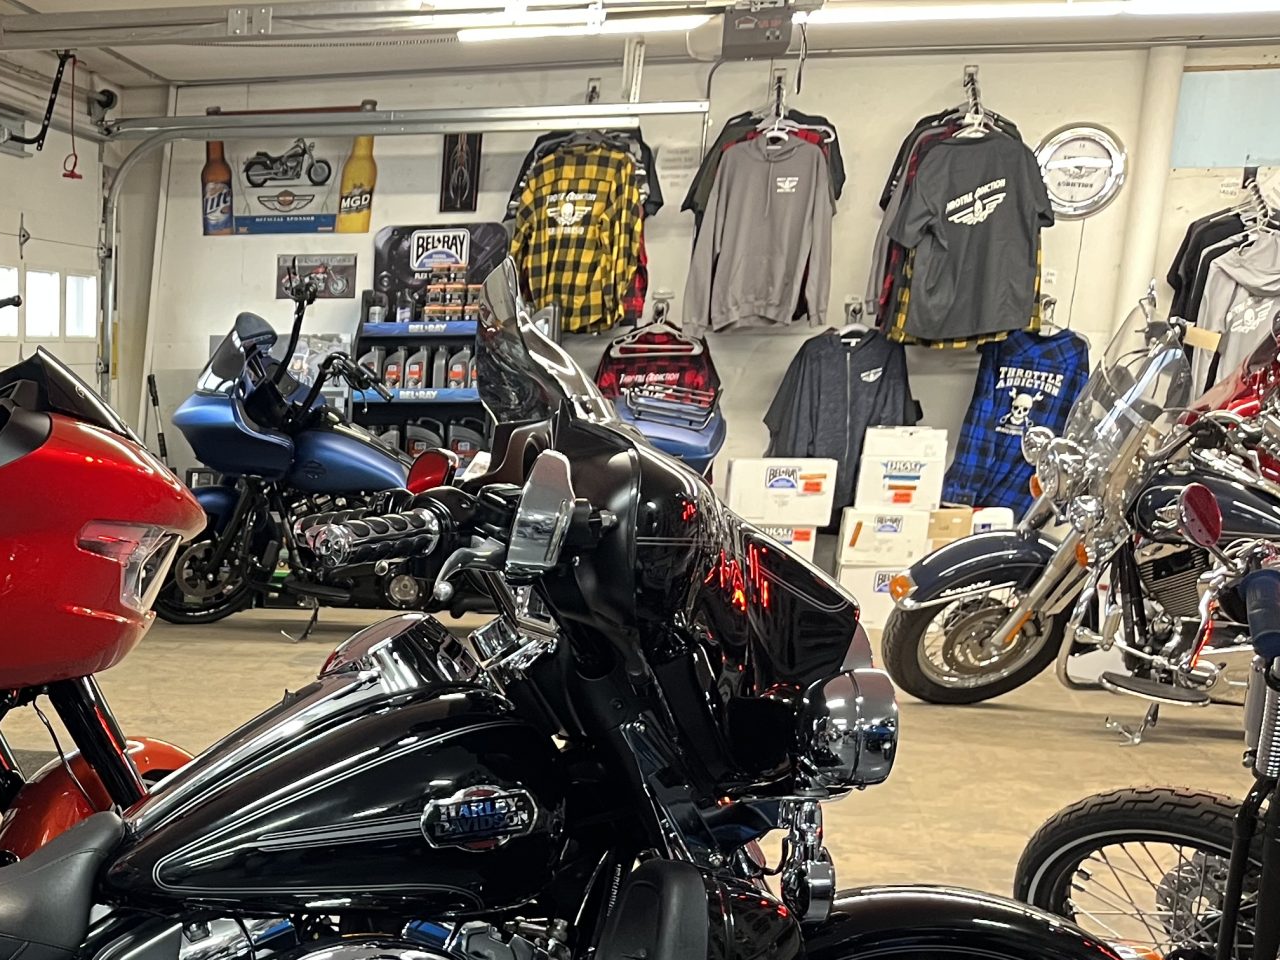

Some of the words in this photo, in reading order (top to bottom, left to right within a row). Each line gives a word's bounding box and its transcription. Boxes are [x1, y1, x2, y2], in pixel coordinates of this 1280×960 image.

[340, 194, 371, 209] MGD
[995, 377, 1060, 397] ADDICTION
[999, 366, 1064, 388] THROTTLE
